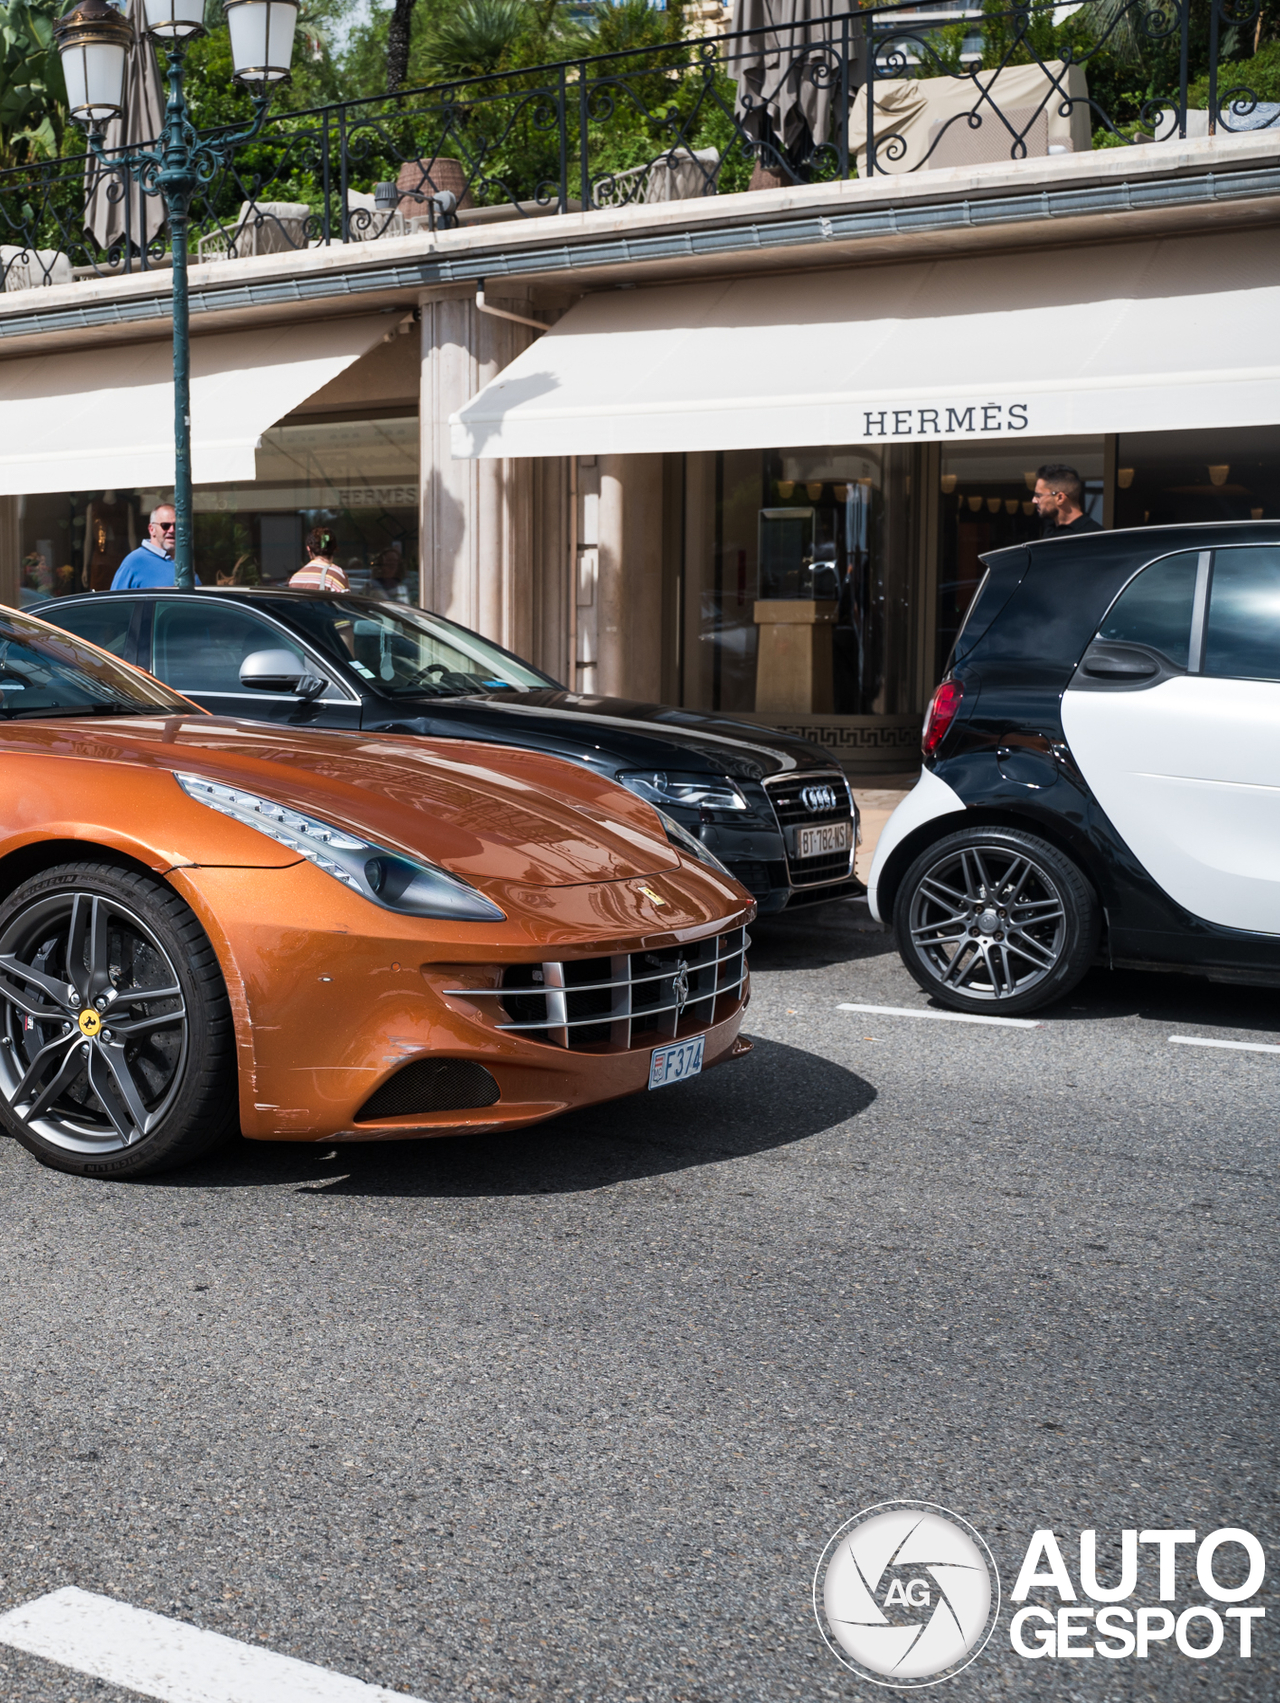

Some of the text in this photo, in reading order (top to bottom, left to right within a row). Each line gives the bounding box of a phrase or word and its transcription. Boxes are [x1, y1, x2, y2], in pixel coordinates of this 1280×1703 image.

[863, 402, 1029, 436] HERMÈS
[803, 825, 845, 855] BT-782-NS
[22, 875, 75, 898] MICHELIN
[664, 1042, 702, 1081] F374
[86, 1152, 141, 1173] MICHELIN
